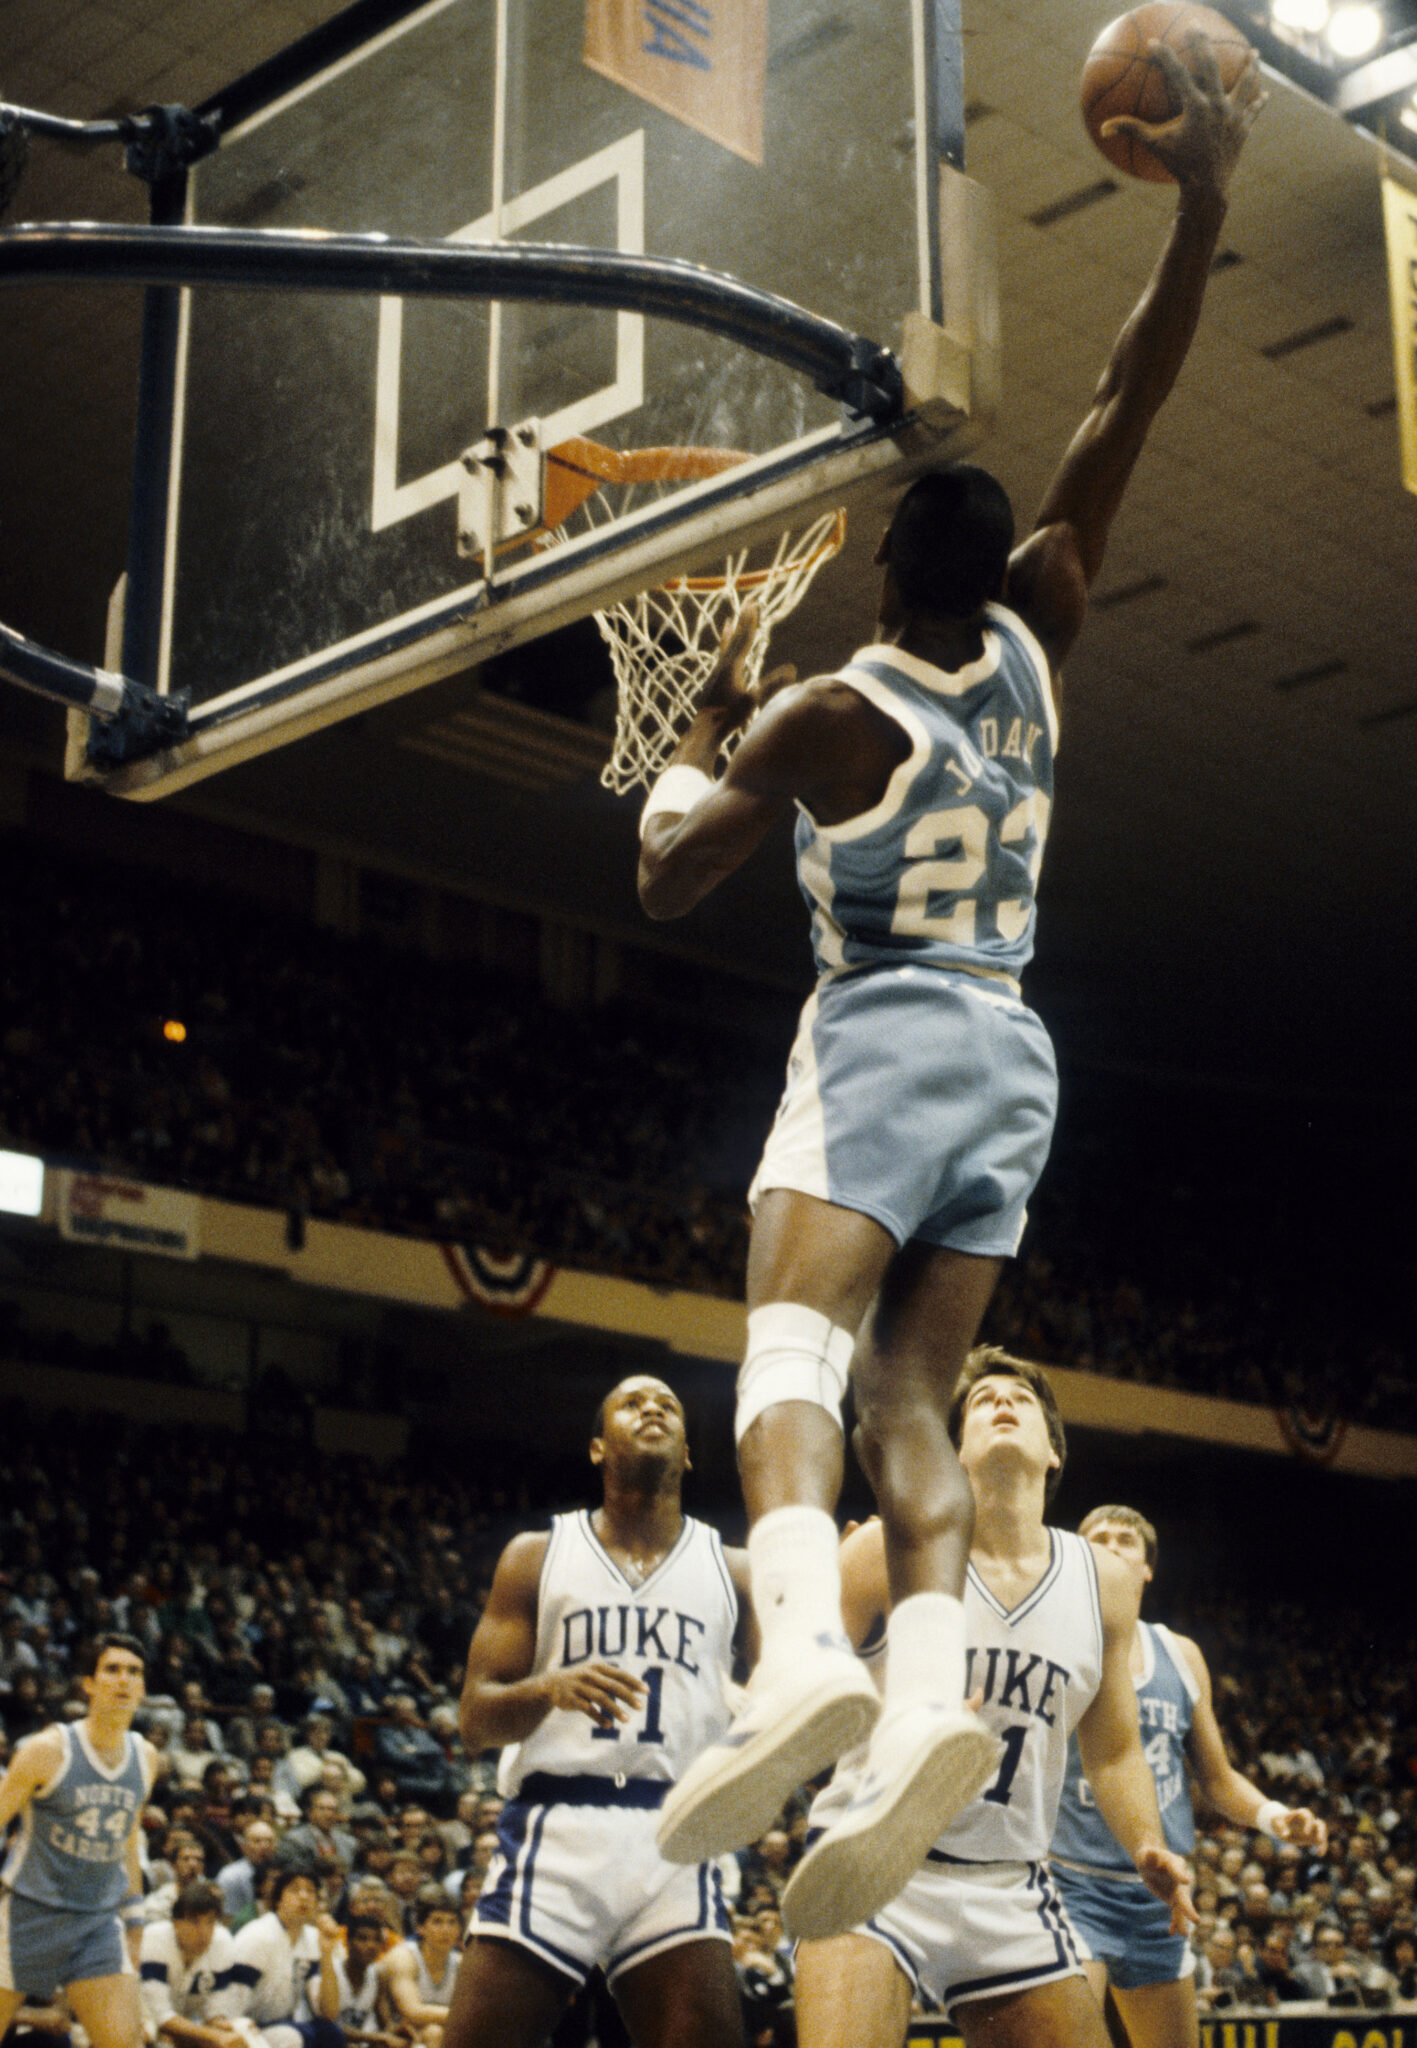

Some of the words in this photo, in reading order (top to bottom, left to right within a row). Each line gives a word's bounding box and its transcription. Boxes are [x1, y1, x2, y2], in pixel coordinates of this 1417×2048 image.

[890, 788, 1050, 944] 23
[561, 1605, 705, 1677] DUKE
[963, 1647, 1071, 1728] UKE
[75, 1806, 128, 1840] 44
